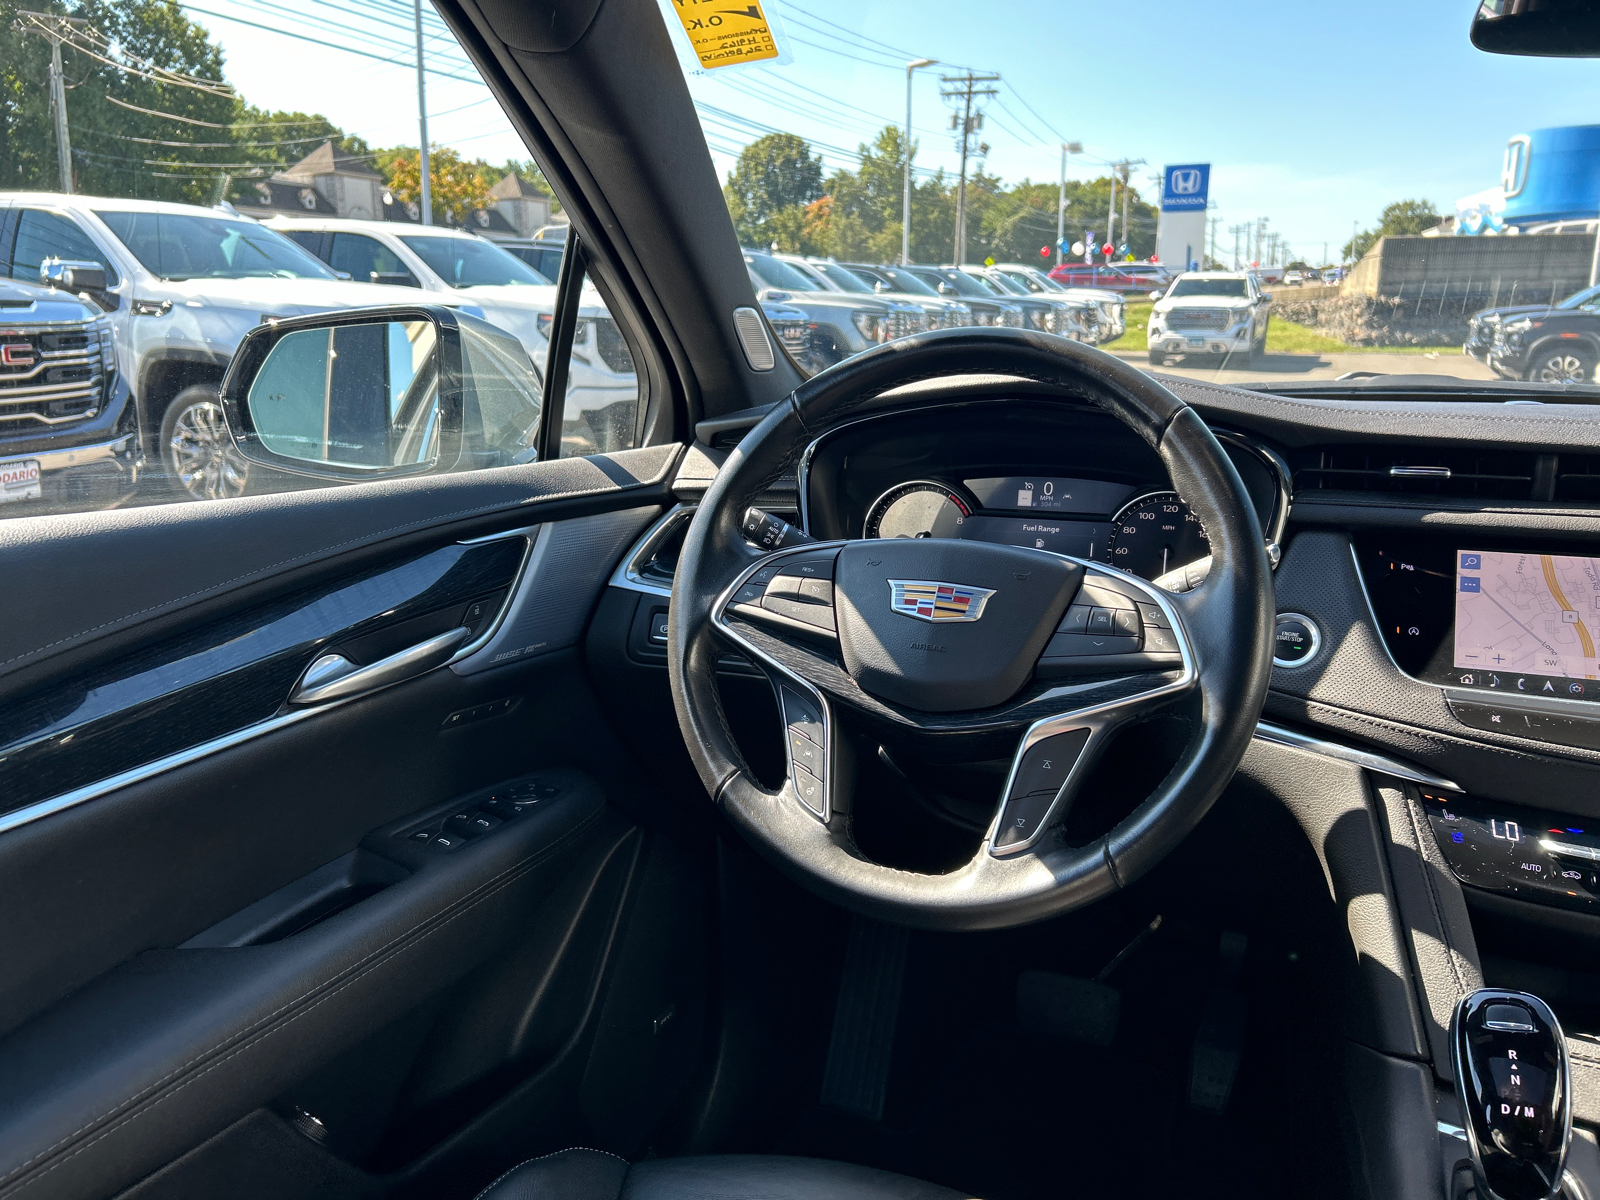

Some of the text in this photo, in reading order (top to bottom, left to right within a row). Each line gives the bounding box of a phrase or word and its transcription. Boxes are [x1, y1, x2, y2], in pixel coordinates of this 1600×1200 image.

[1163, 196, 1206, 206] HONDA
[0, 467, 38, 484] DARIO
[1043, 481, 1054, 496] 0
[1162, 505, 1179, 513] 120
[956, 517, 963, 525] 8
[1139, 512, 1155, 520] 100
[1022, 524, 1060, 534] Fuel Range
[1122, 526, 1136, 534] 80
[1115, 547, 1128, 555] 60
[1515, 555, 1527, 575] Forest
[1583, 566, 1597, 583] Todd
[1276, 635, 1304, 643] START/STOP
[1281, 630, 1300, 638] ENGINE
[910, 642, 947, 652] AIRBAG
[1543, 658, 1558, 667] SW
[1520, 862, 1542, 873] AUTO
[1507, 1049, 1518, 1060] R
[1510, 1074, 1521, 1086] N
